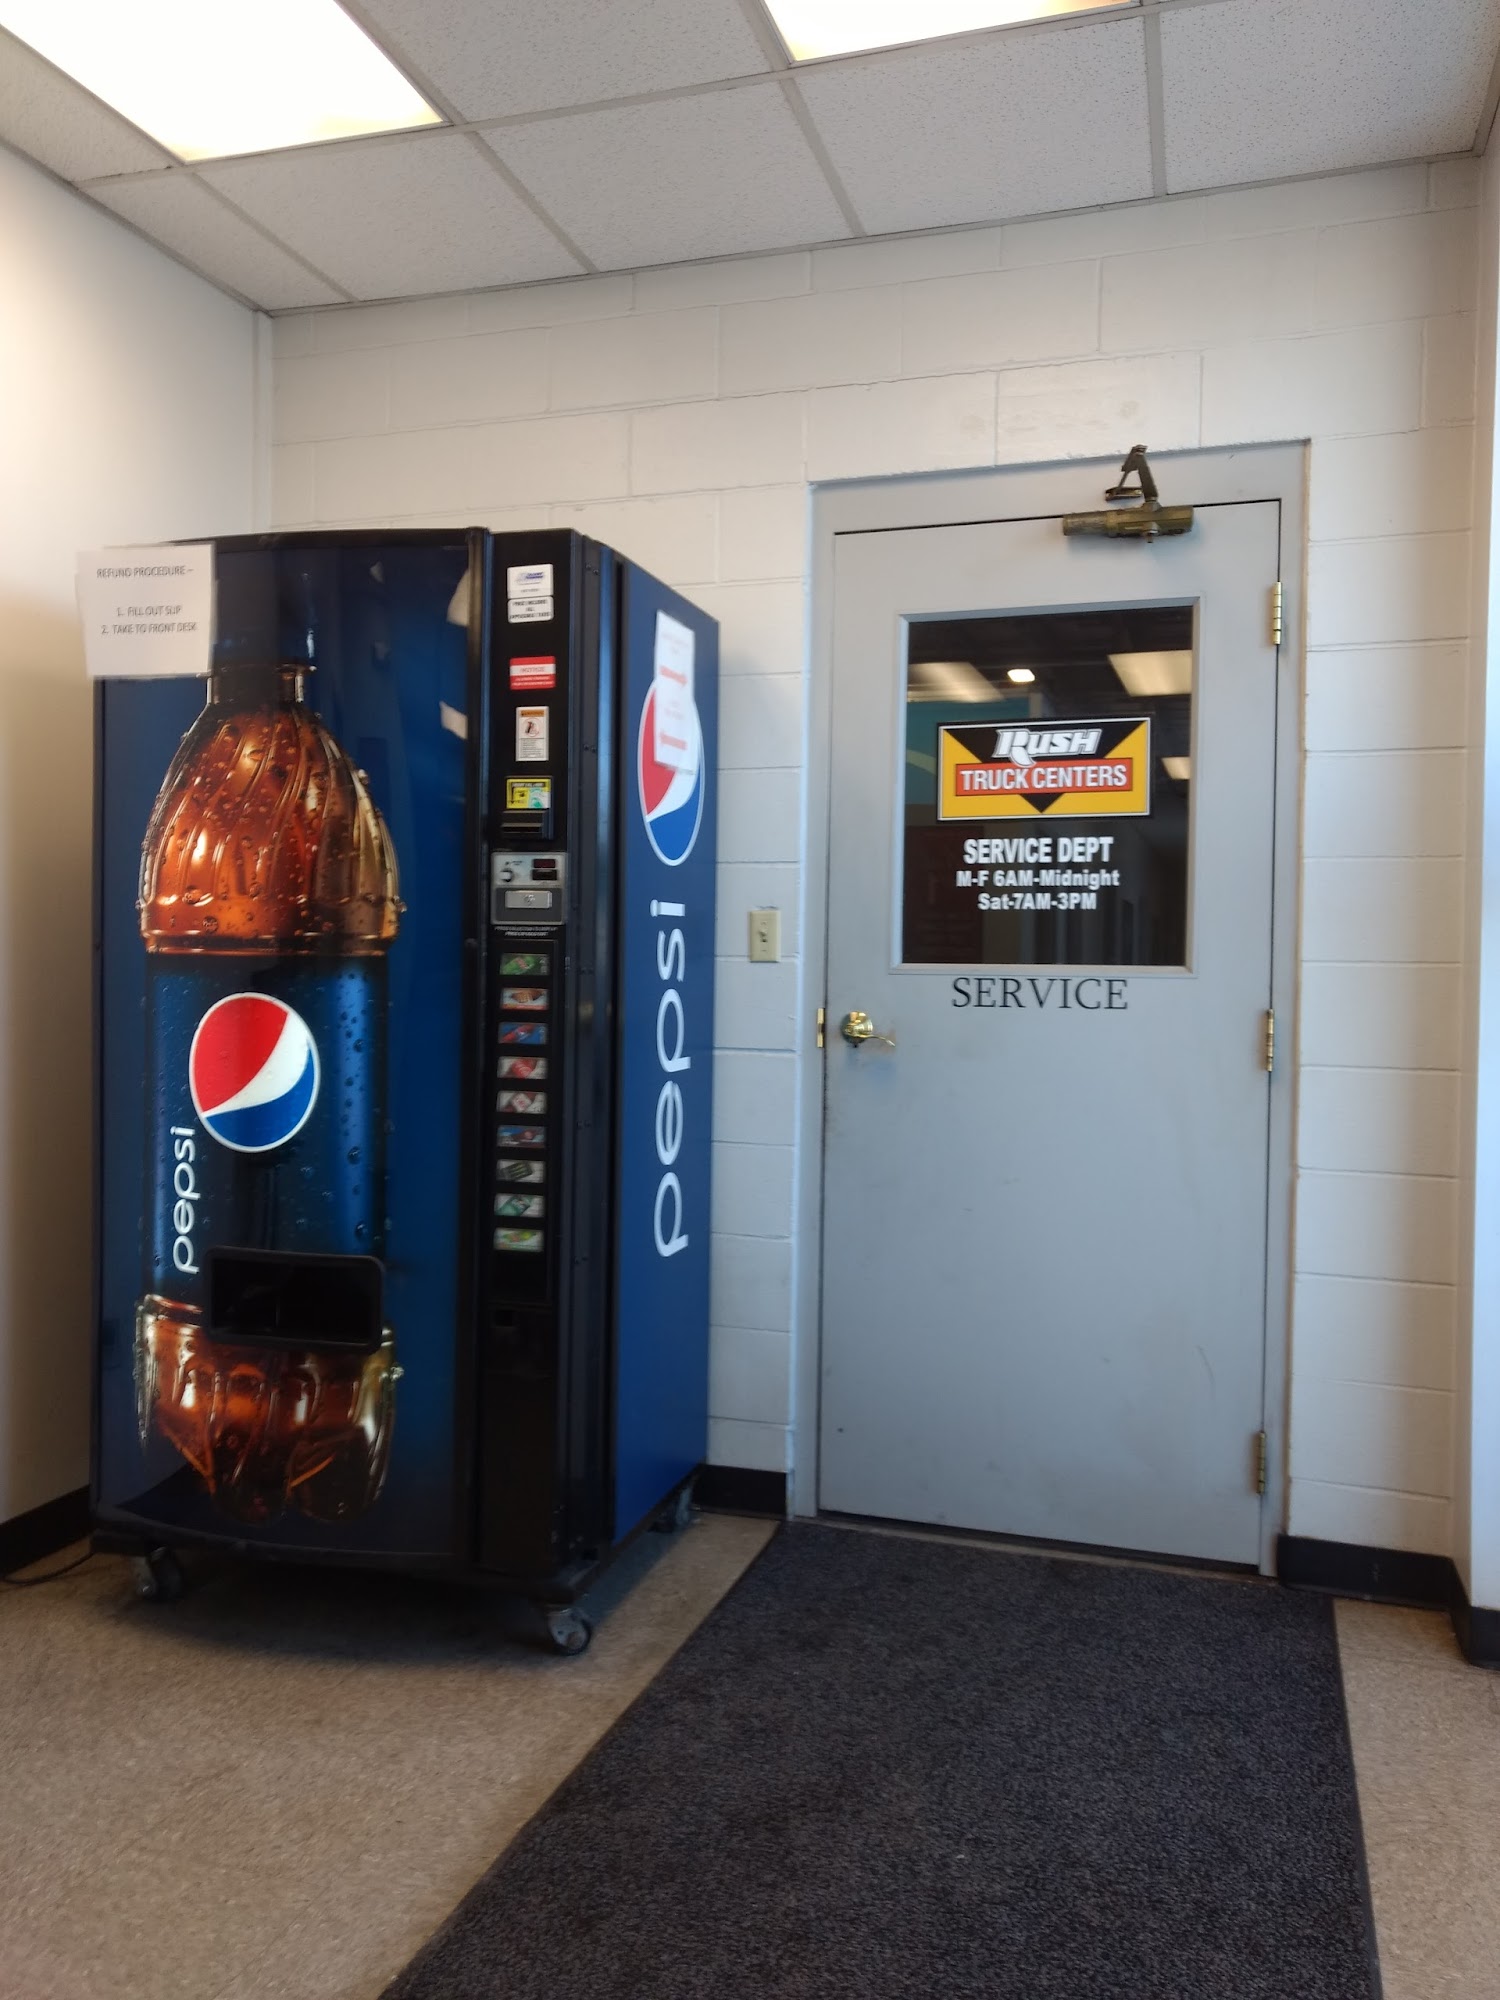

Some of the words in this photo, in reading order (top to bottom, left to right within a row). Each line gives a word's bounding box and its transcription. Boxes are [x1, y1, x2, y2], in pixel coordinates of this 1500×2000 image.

[96, 567, 132, 579] REFUND
[133, 565, 186, 577] PROCEDURE
[117, 606, 124, 617] 1.
[127, 606, 144, 617] FILL
[145, 605, 164, 616] OUT
[165, 604, 182, 615] SLIP
[101, 624, 109, 635] 2.
[112, 623, 134, 635] TAKE
[136, 623, 147, 634] TO
[148, 622, 176, 634] FRONT
[177, 621, 198, 632] DESK
[992, 728, 1102, 768] RUSH
[960, 768, 1029, 791] TRUCK
[1031, 765, 1127, 788] CENTERS
[963, 837, 1052, 864] SERVICE
[1057, 836, 1114, 863] DEPT
[956, 870, 989, 887] M-F
[993, 869, 1120, 890] 6AM-Midnight
[977, 892, 1097, 910] Sat-7AM-3PM
[952, 977, 1128, 1010] SERVICE
[649, 898, 691, 1258] pepsi
[170, 1125, 201, 1275] pepsi
